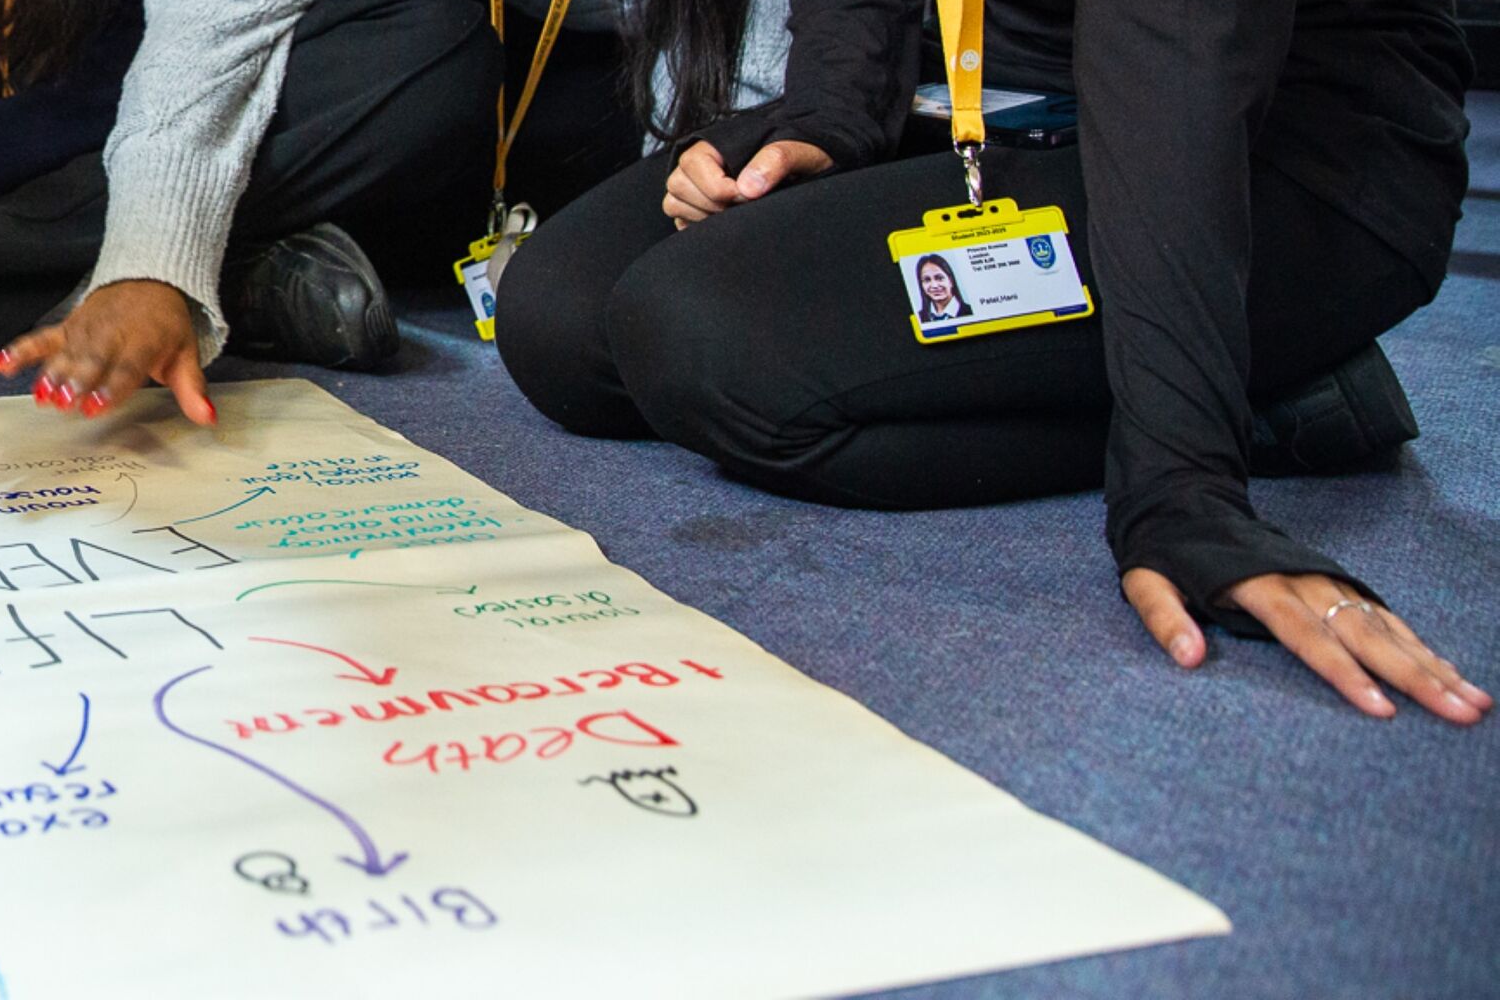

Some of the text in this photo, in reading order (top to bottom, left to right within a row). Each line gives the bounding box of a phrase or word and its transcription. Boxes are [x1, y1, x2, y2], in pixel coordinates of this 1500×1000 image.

[265, 456, 357, 471] office
[330, 496, 466, 518] domestic
[285, 509, 477, 537] child abuse
[503, 607, 641, 628] natural
[382, 708, 682, 773] Death
[276, 888, 498, 944] Birth
